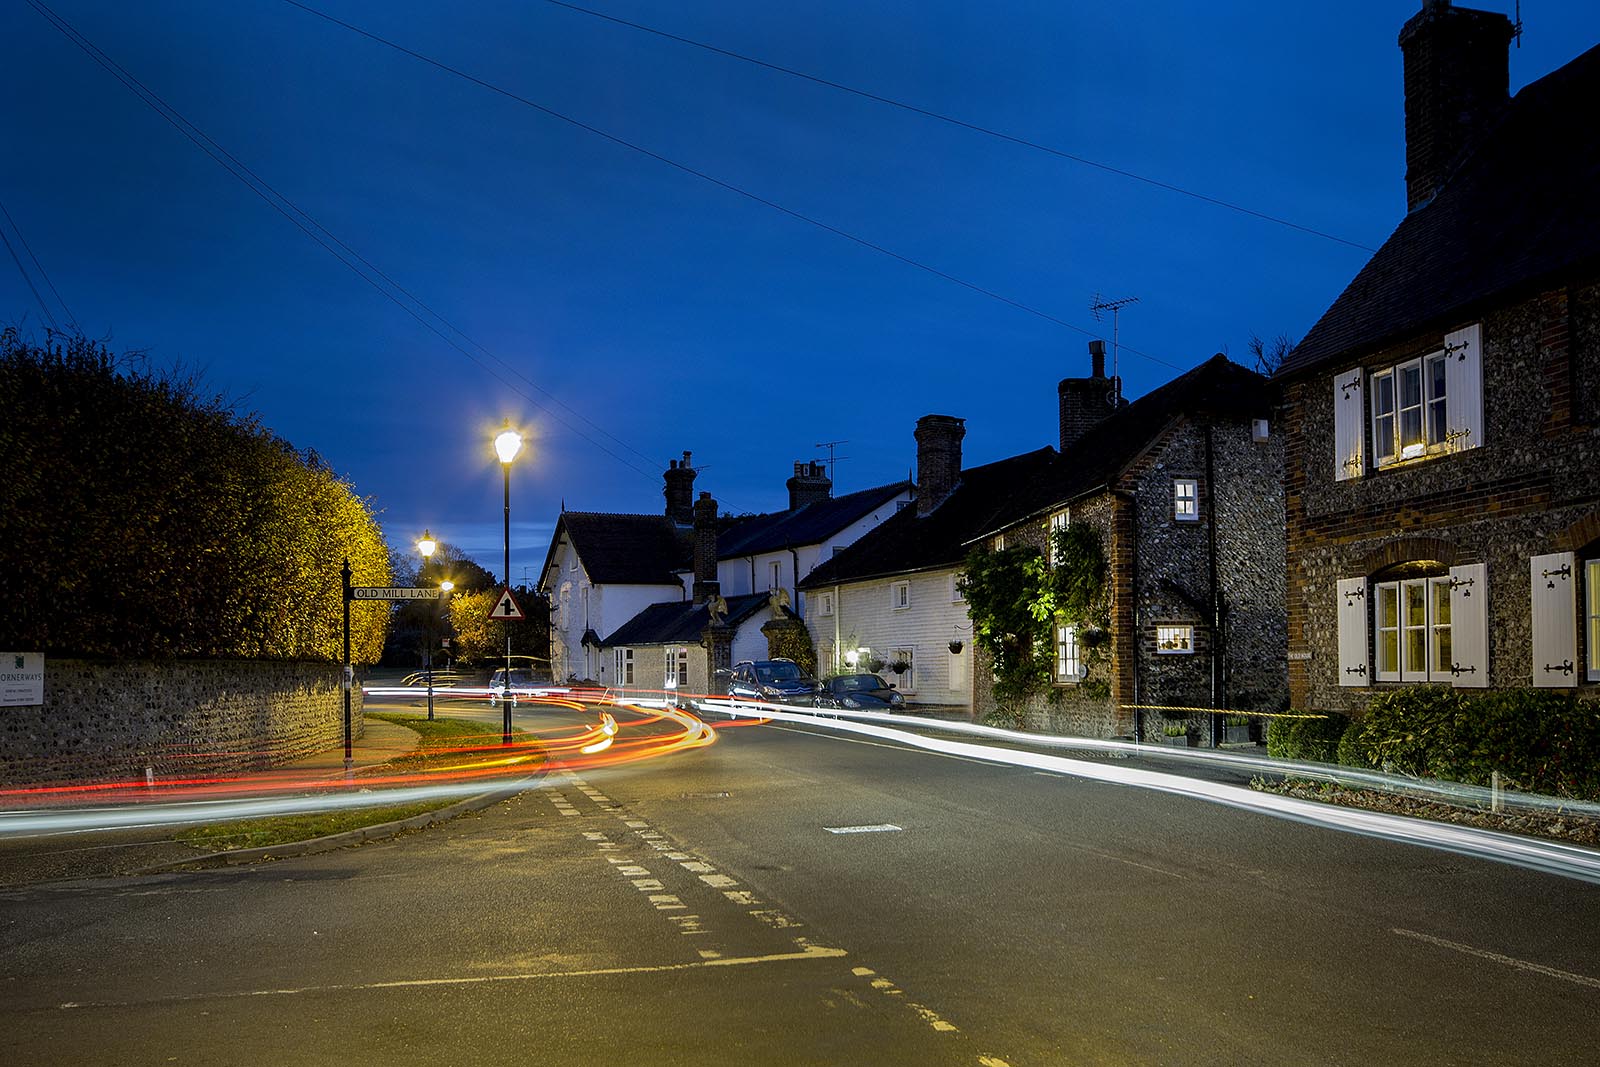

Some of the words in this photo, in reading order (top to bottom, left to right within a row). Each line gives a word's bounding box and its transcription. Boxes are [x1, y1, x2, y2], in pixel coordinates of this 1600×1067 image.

[357, 589, 378, 598] OLD
[382, 589, 406, 598] MILL
[411, 589, 438, 598] LANE
